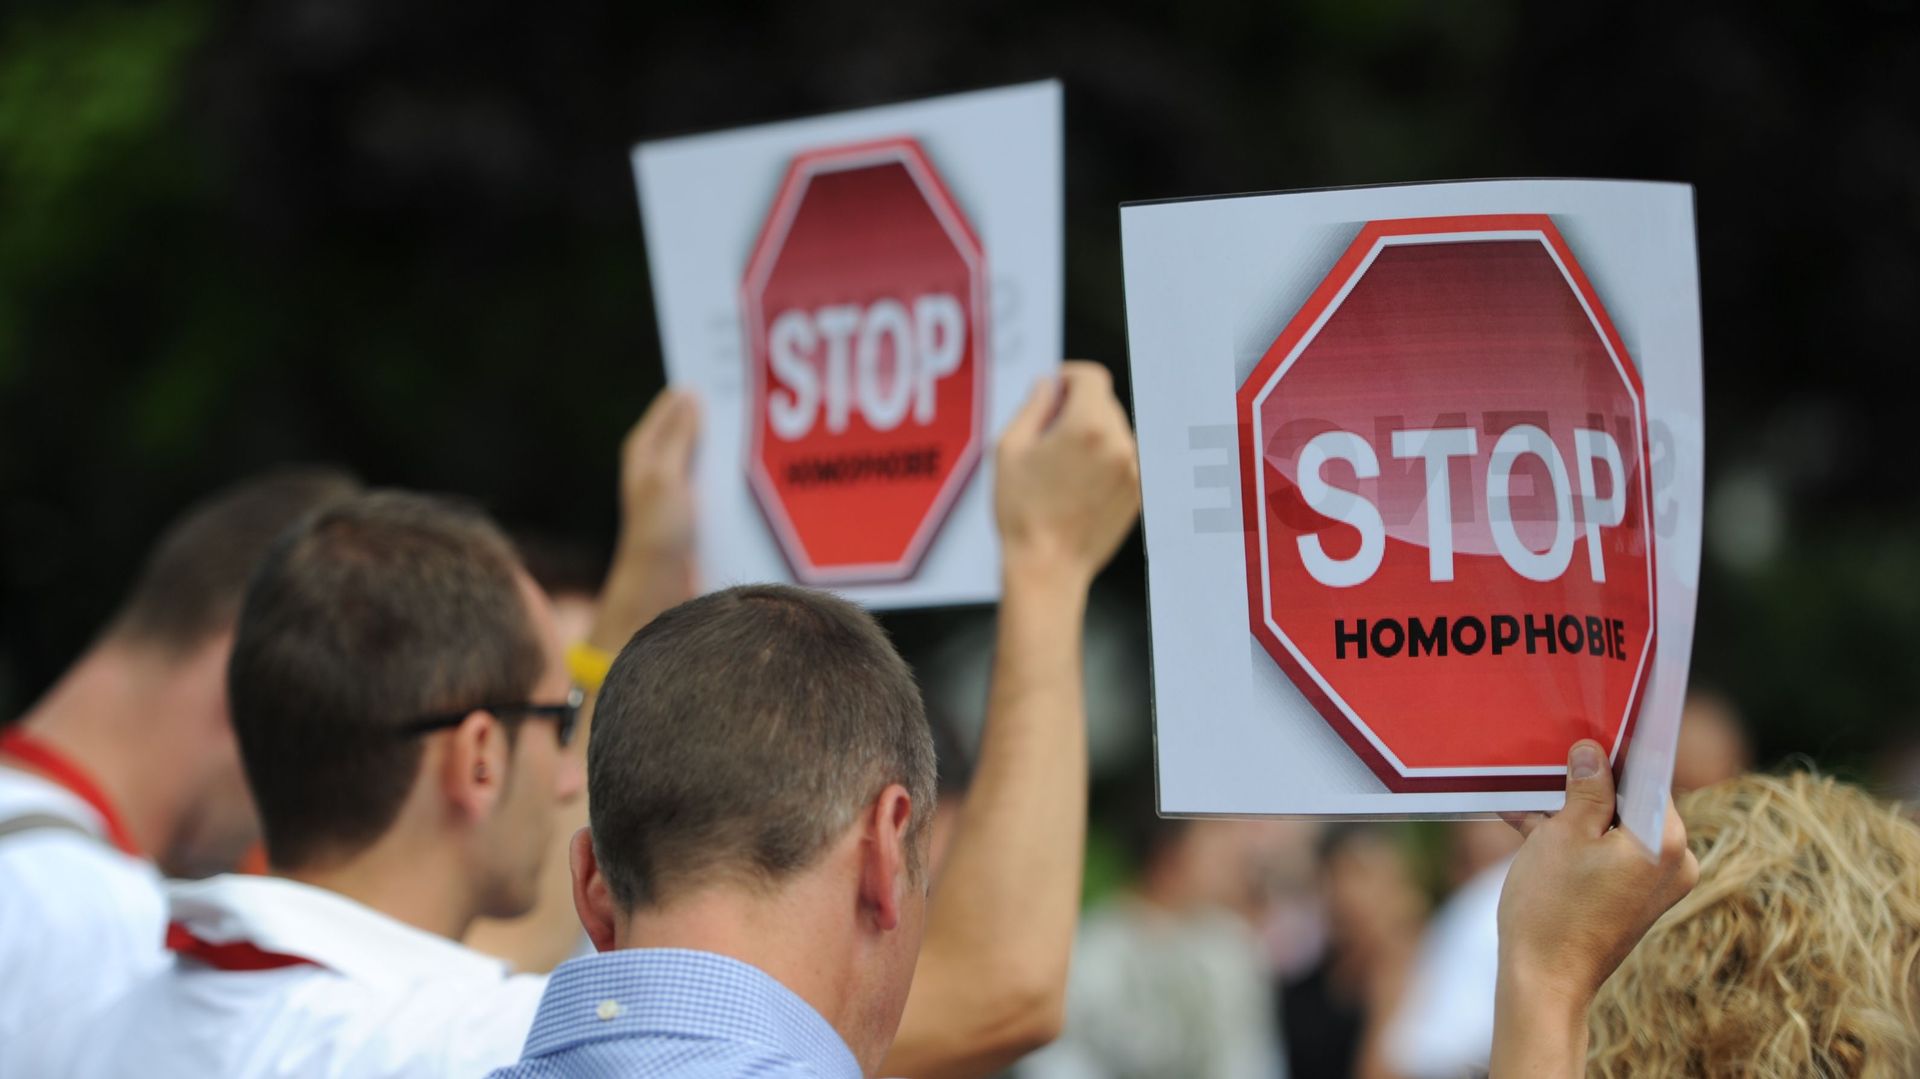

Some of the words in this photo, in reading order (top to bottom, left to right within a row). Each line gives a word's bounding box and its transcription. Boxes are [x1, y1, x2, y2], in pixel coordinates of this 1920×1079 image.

[767, 293, 966, 441] STOP
[1296, 423, 1626, 588] STOP
[1334, 613, 1627, 661] HOMOPHOBIE
